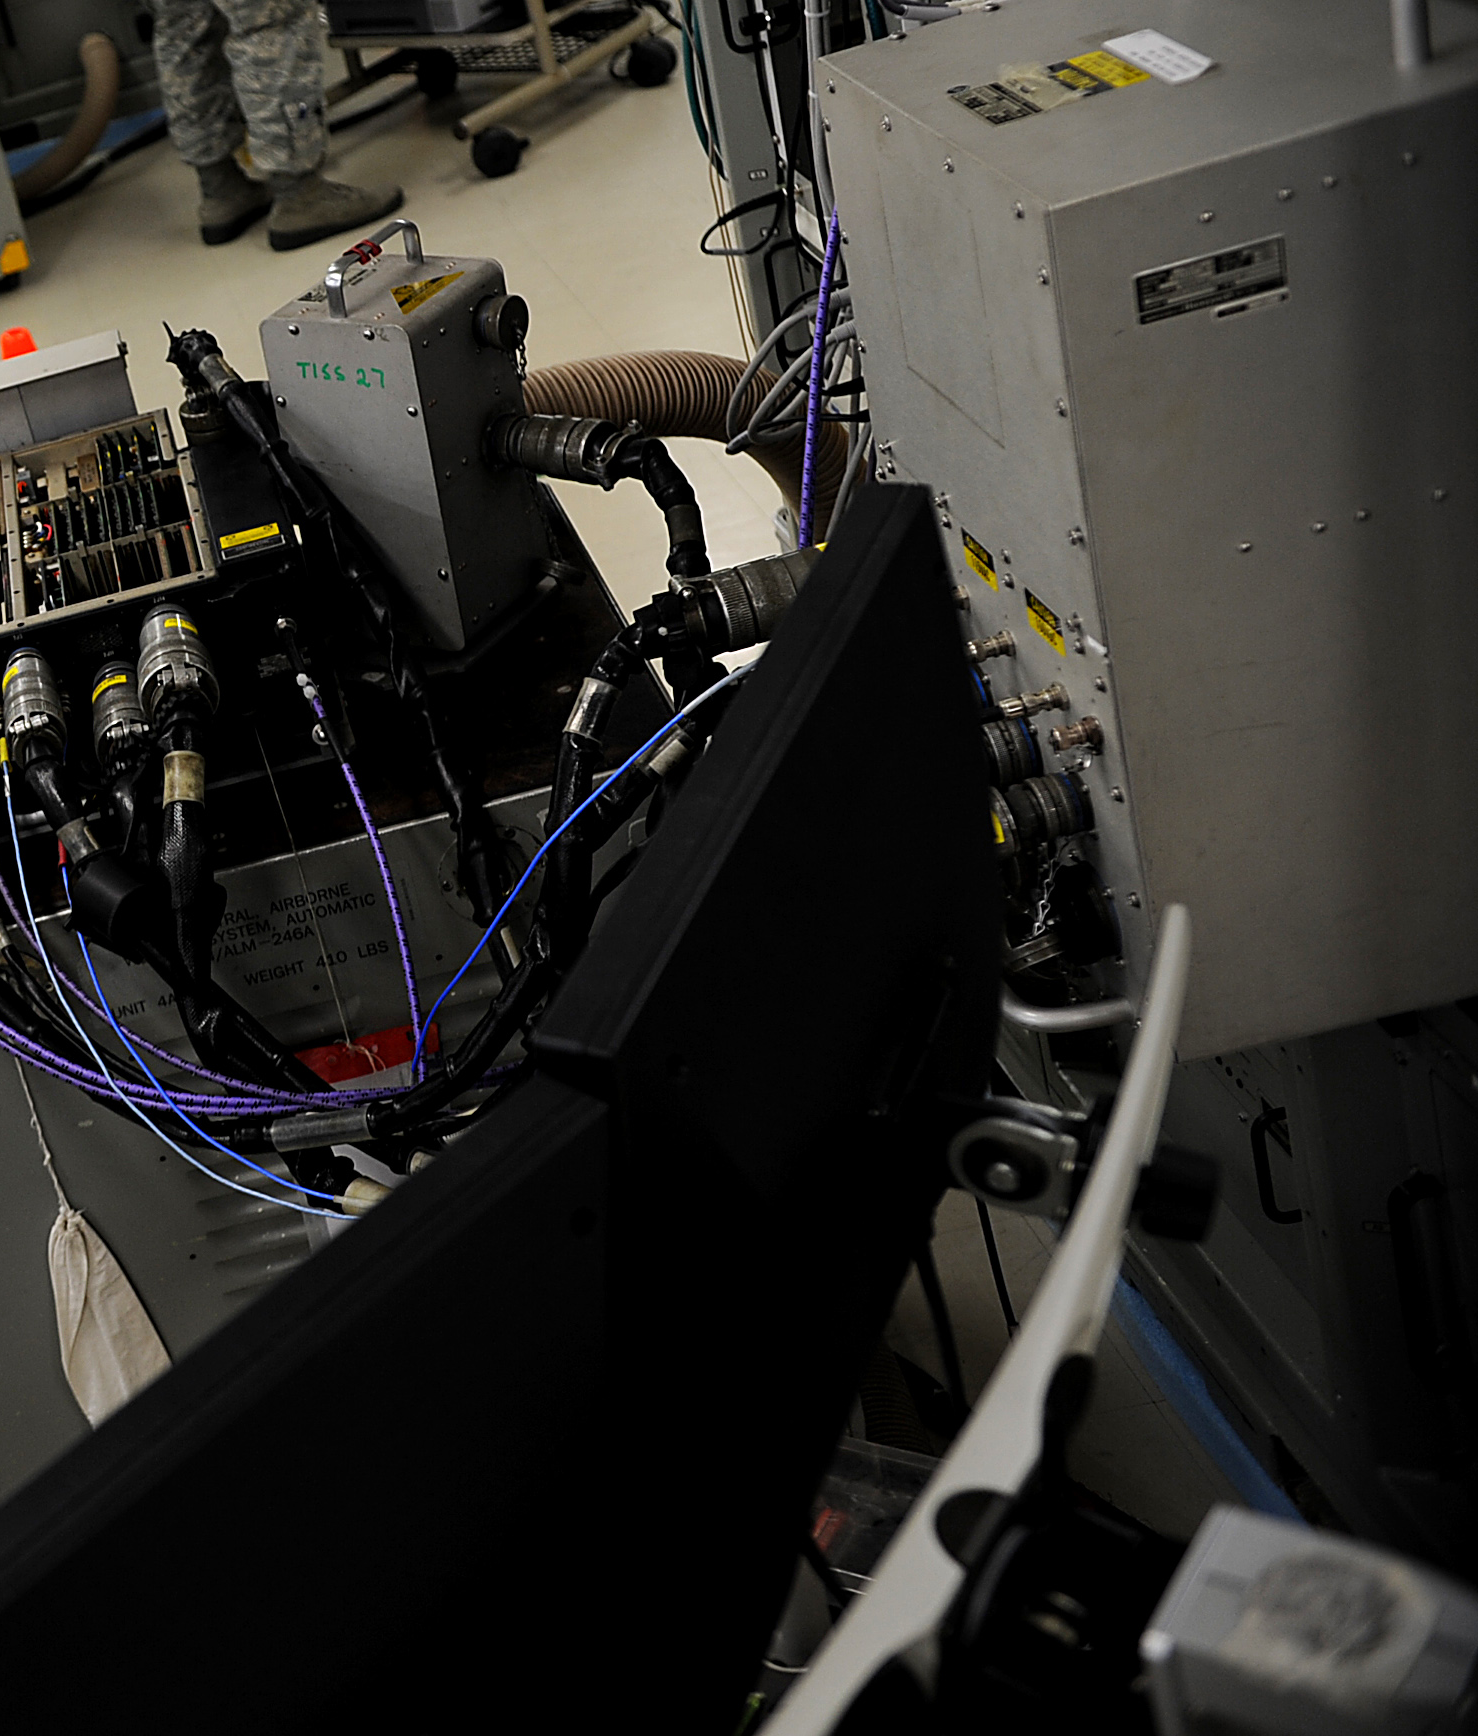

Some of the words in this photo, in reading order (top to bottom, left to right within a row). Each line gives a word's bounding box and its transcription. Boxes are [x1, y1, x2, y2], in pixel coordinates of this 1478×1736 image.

[296, 362, 345, 381] TISS
[357, 367, 385, 389] 27
[224, 908, 260, 925] RAL,
[269, 882, 351, 914] AIRBORNE
[286, 892, 377, 927] AUTOMATIC
[211, 924, 315, 963] /ALM-246A
[243, 960, 305, 986] WEIGHT
[315, 950, 348, 968] 410
[357, 940, 389, 959] LBS
[110, 1000, 146, 1020] UNIT
